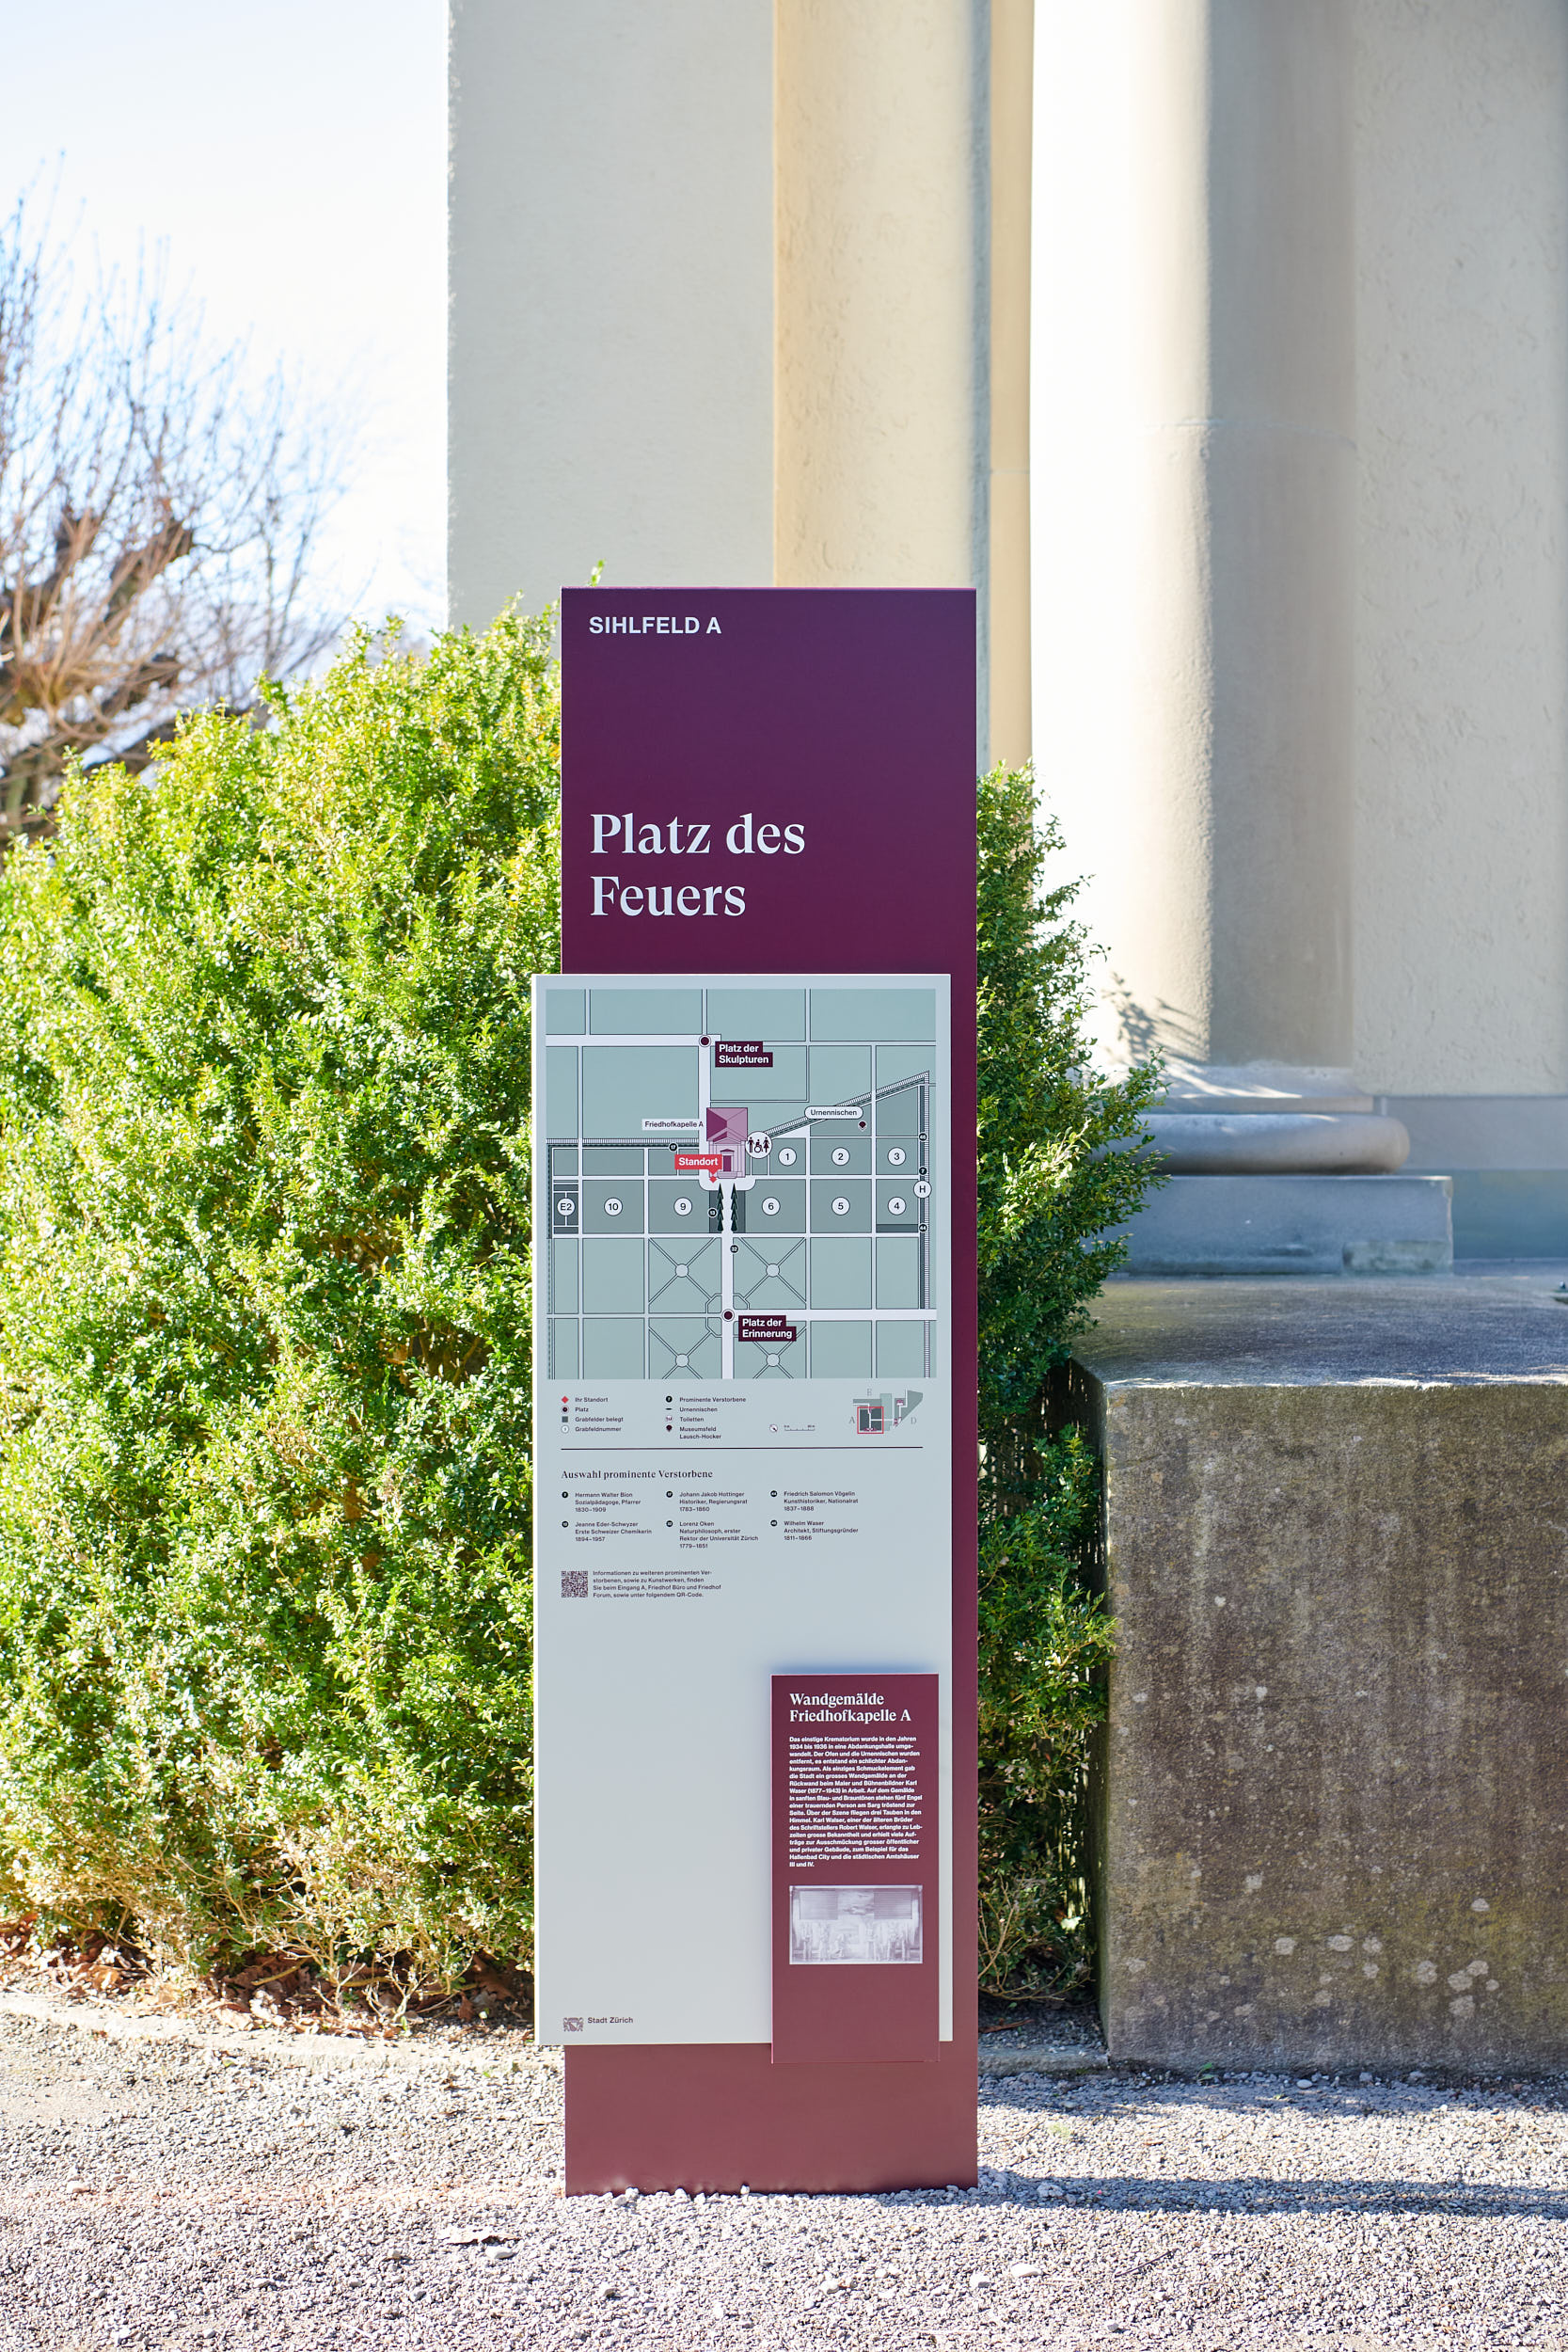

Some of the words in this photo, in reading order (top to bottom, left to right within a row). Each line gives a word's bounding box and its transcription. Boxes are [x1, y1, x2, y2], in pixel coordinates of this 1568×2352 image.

[589, 616, 700, 634] SIHLFELD
[706, 616, 722, 634] A
[590, 812, 711, 854] Platz
[726, 812, 805, 854] des
[590, 876, 746, 917] Feuers
[719, 1044, 740, 1053] Platz
[743, 1044, 759, 1053] der
[719, 1055, 769, 1065] Skulpturen
[785, 1153, 790, 1161] 1
[837, 1153, 844, 1161] 2
[893, 1152, 900, 1161] 3
[678, 1157, 718, 1166] Standort
[560, 1203, 572, 1211] E2
[608, 1203, 619, 1211] 10
[679, 1203, 687, 1211] 9
[767, 1202, 775, 1211] 6
[837, 1202, 845, 1211] 5
[893, 1202, 901, 1211] 4
[742, 1318, 764, 1328] Platz
[767, 1318, 782, 1328] der
[742, 1329, 792, 1340] Erinnerung
[561, 1470, 601, 1478] Auswahl
[603, 1470, 656, 1480] prominente
[657, 1470, 713, 1478] Verstorbene
[790, 1693, 884, 1708] Wandgemälde
[790, 1709, 896, 1724] Friedhofkapelle
[900, 1709, 911, 1722] A
